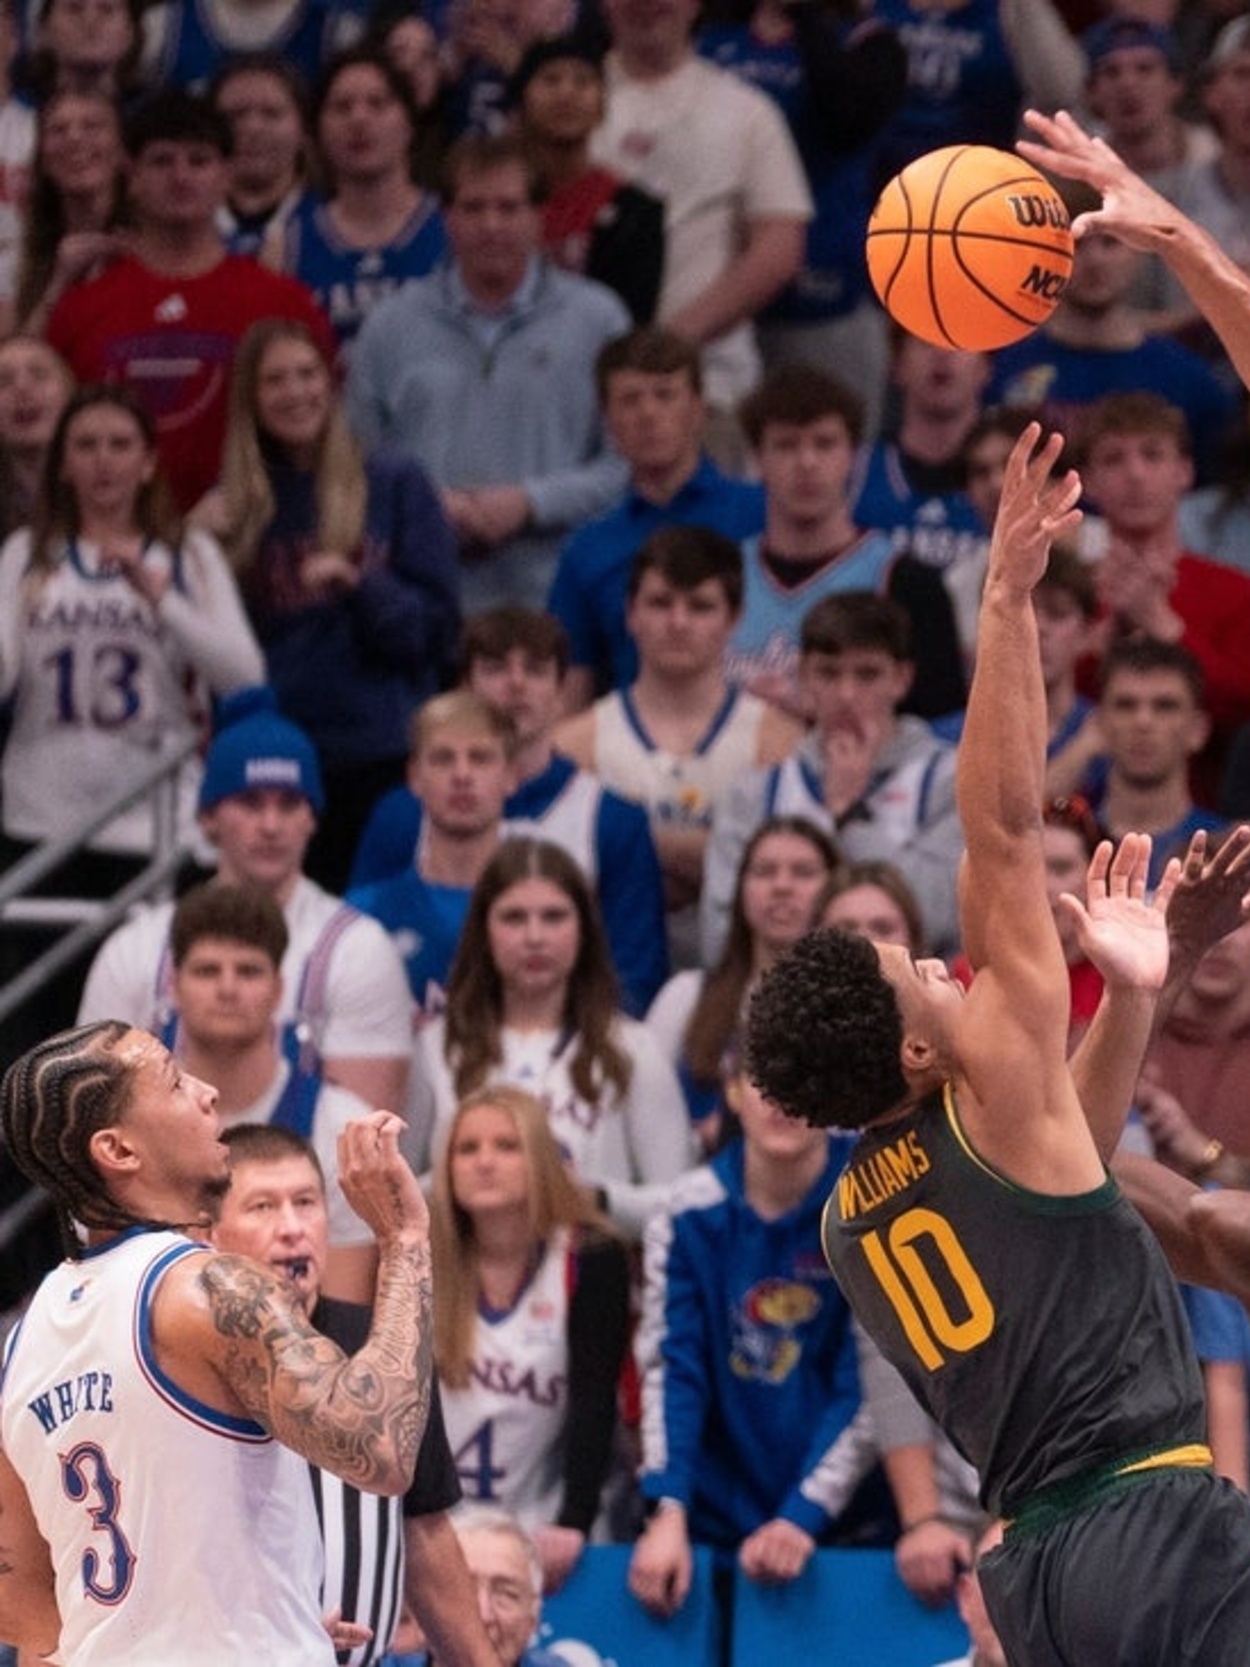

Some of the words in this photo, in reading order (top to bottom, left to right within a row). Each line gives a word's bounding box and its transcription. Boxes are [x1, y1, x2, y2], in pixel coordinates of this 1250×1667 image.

[45, 644, 142, 729] 13
[859, 1207, 996, 1373] 10
[28, 1371, 114, 1435] WHITE
[468, 1356, 567, 1407] NSAS
[455, 1417, 506, 1501] 4
[57, 1441, 137, 1606] 3
